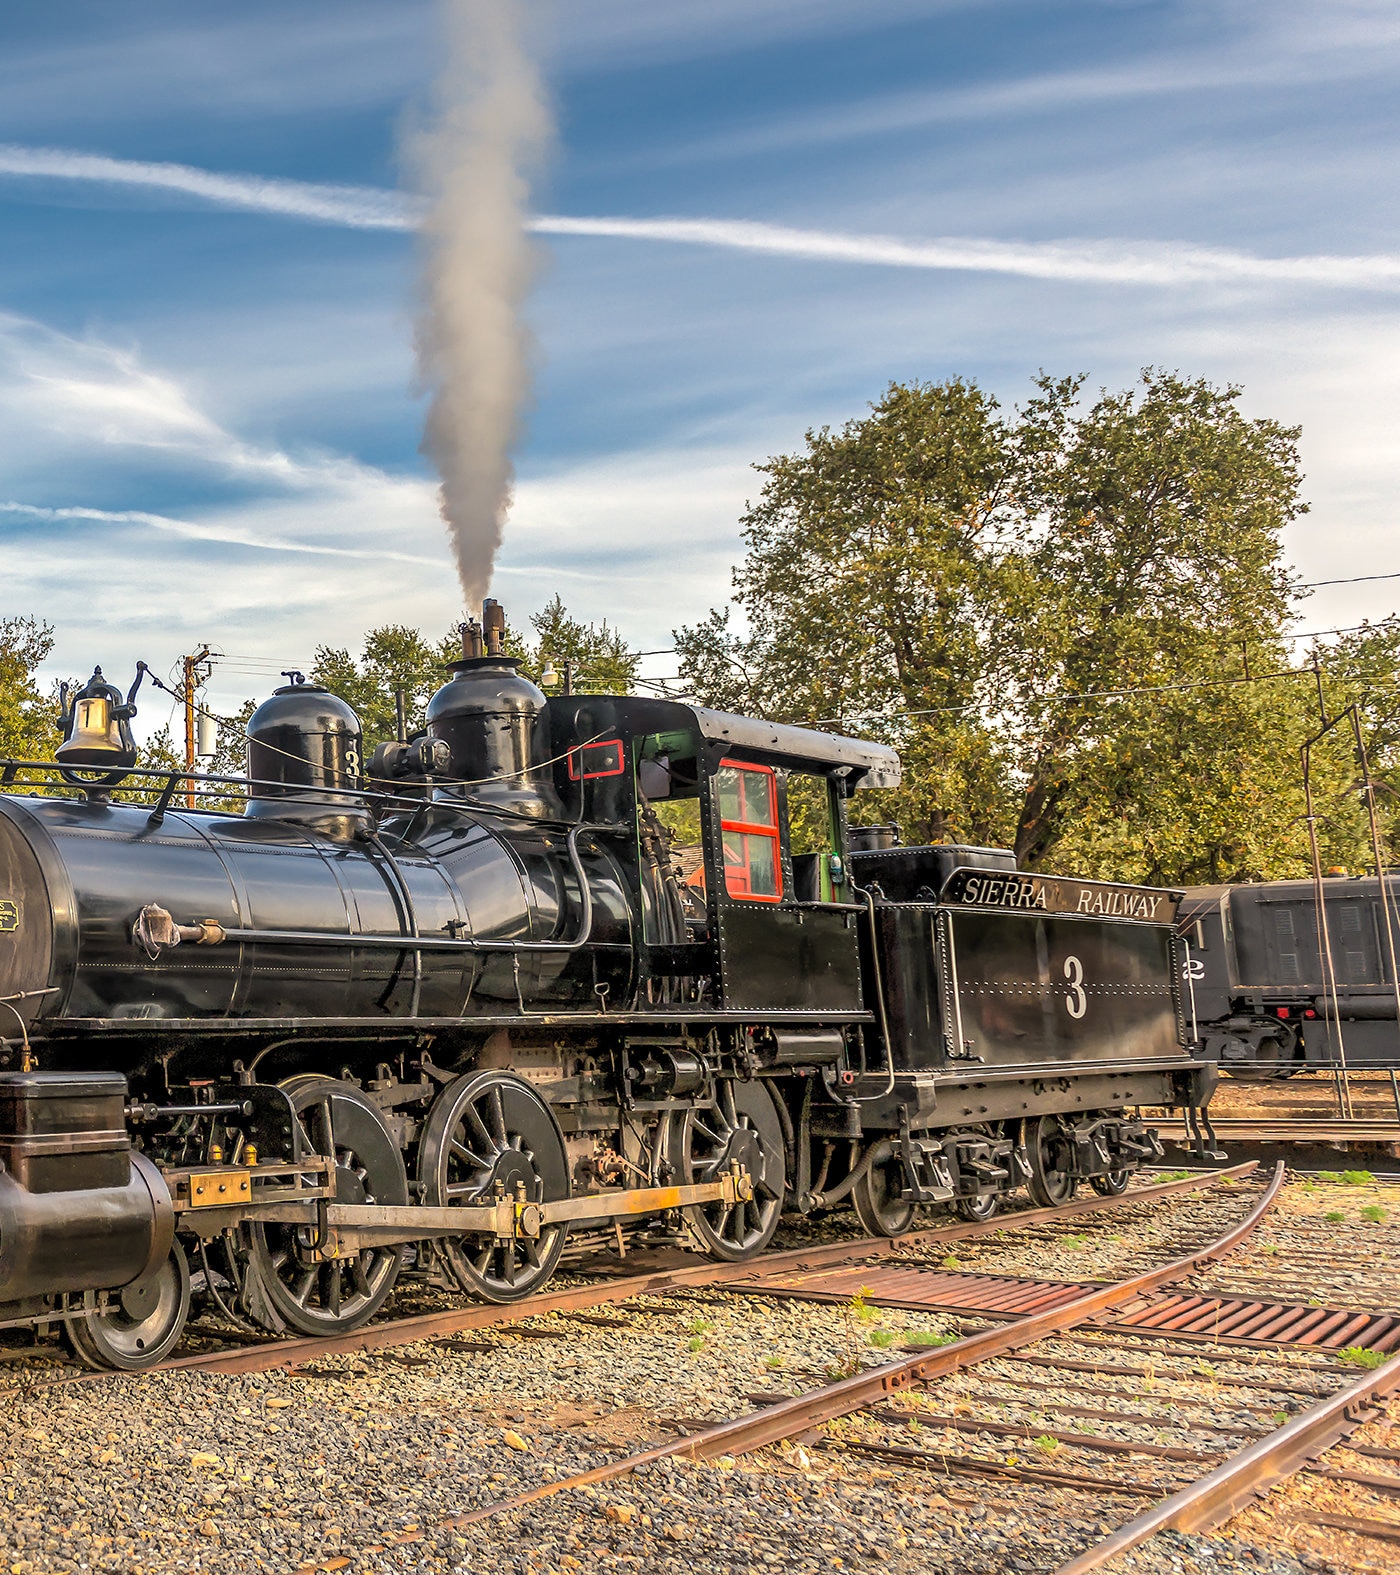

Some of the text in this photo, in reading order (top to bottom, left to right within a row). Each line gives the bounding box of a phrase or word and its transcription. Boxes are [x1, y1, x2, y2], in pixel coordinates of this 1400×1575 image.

[345, 751, 360, 779] 3
[961, 877, 1163, 918] SIERRA RAILWAY
[1182, 959, 1205, 980] 2
[1063, 955, 1087, 1019] 3
